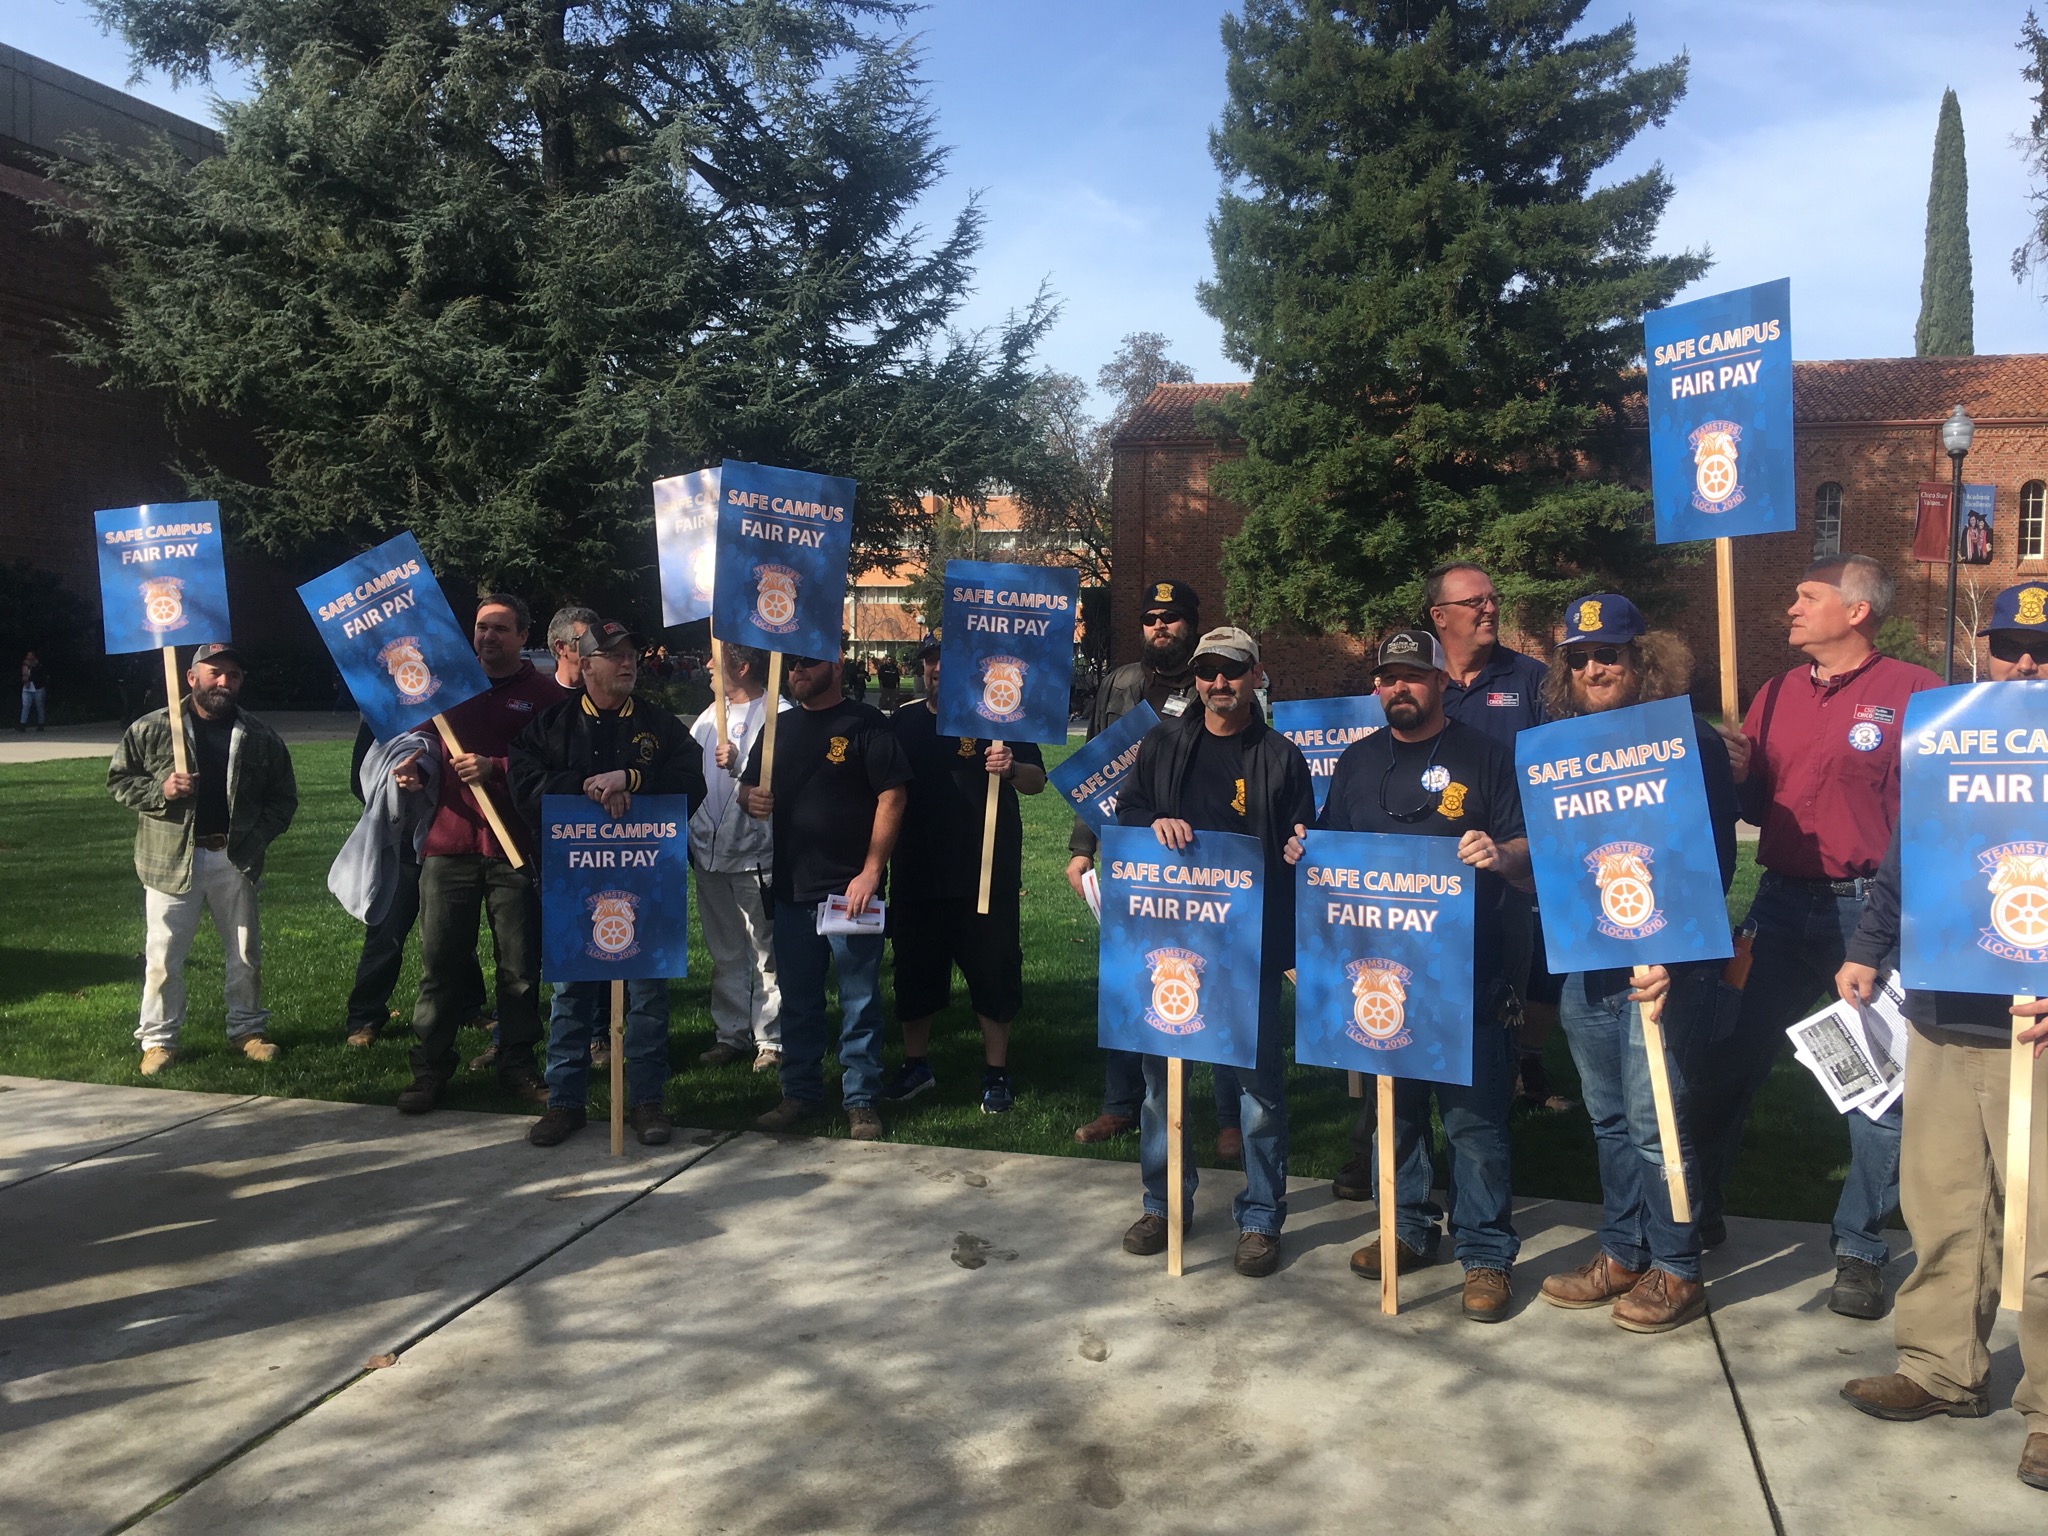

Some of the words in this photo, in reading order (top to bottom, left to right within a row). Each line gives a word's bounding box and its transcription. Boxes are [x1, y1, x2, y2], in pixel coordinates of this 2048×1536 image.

[1654, 339, 1695, 366] SAFE
[1698, 320, 1780, 356] CAMPUS
[1671, 370, 1715, 400] FAIR
[1719, 359, 1762, 390] PAY
[1691, 422, 1740, 440] TEAMSTERS
[1695, 500, 1720, 512] LOCAL
[1722, 495, 1743, 511] 2010
[1920, 491, 1935, 499] Chico
[728, 489, 769, 511] SAFE
[771, 497, 844, 523] CAMPUS
[105, 528, 143, 544] SAFE
[145, 522, 212, 539] CAMPUS
[675, 514, 707, 533] FAIR
[741, 518, 783, 542] FAIR
[787, 526, 825, 549] PAY
[122, 546, 161, 565] FAIR
[164, 543, 199, 558] PAY
[755, 565, 802, 583] TEAMSTERS
[318, 592, 357, 622] SAFE
[355, 559, 420, 601] CAMPUS
[953, 587, 994, 604] SAFE
[997, 591, 1068, 611] CAMPUS
[342, 608, 383, 639] FAIR
[381, 588, 416, 619] PAY
[752, 616, 775, 632] LOCAL
[778, 624, 797, 632] 2010
[967, 615, 1009, 634] FAIR
[1013, 618, 1050, 637] PAY
[982, 656, 1026, 669] TEAMSTERS
[403, 692, 425, 704] LOCAL
[425, 681, 441, 697] 2010
[979, 708, 1001, 721] LOCAL
[1005, 711, 1022, 720] 2010
[1283, 730, 1324, 746] SAFE
[1326, 726, 1384, 745] CAMP
[1918, 729, 1998, 755] SAFE
[1071, 771, 1107, 803] SAFE
[1102, 738, 1143, 779] CAMP
[1528, 757, 1583, 785] SAFE
[1585, 738, 1686, 774] CAMPUS
[1948, 774, 2034, 803] FAIR
[1098, 791, 1119, 818] FA
[1553, 789, 1613, 820] FAIR
[1616, 779, 1668, 810] PAY
[551, 824, 597, 839] SAFE
[600, 823, 677, 839] CAMPUS
[569, 851, 616, 868] FAIR
[621, 850, 659, 867] PAY
[1588, 843, 1650, 862] TEAMSTERS
[1112, 861, 1159, 882] SAFE
[1163, 865, 1253, 890] CAMPUS
[1307, 867, 1360, 889] SAFE
[1363, 871, 1462, 896] CAMPUS
[588, 892, 639, 903] TEAMSTERS
[1129, 895, 1180, 920] FAIR
[1185, 900, 1232, 924] PAY
[1327, 902, 1382, 929] FAIR
[1388, 907, 1439, 932] PAY
[1602, 925, 1636, 938] LOCAL
[1639, 919, 1663, 937] 2010
[588, 948, 616, 960] LOCAL
[619, 948, 637, 960] 2010
[1149, 948, 1203, 965] TEAMSTERS
[1984, 938, 2033, 961] LOCAL
[1349, 959, 1409, 977] TEAMSTERS
[1147, 1015, 1177, 1034] LOCAL
[1180, 1022, 1201, 1034] 2010
[1831, 1012, 1851, 1038] Students?
[1350, 1030, 1381, 1048] LOCAL
[1385, 1037, 1408, 1048] 2010
[1847, 1036, 1856, 1047] for
[1852, 1044, 1867, 1063] Unsafe
[1863, 1061, 1876, 1077] State
[1872, 1075, 1881, 1085] Cal
